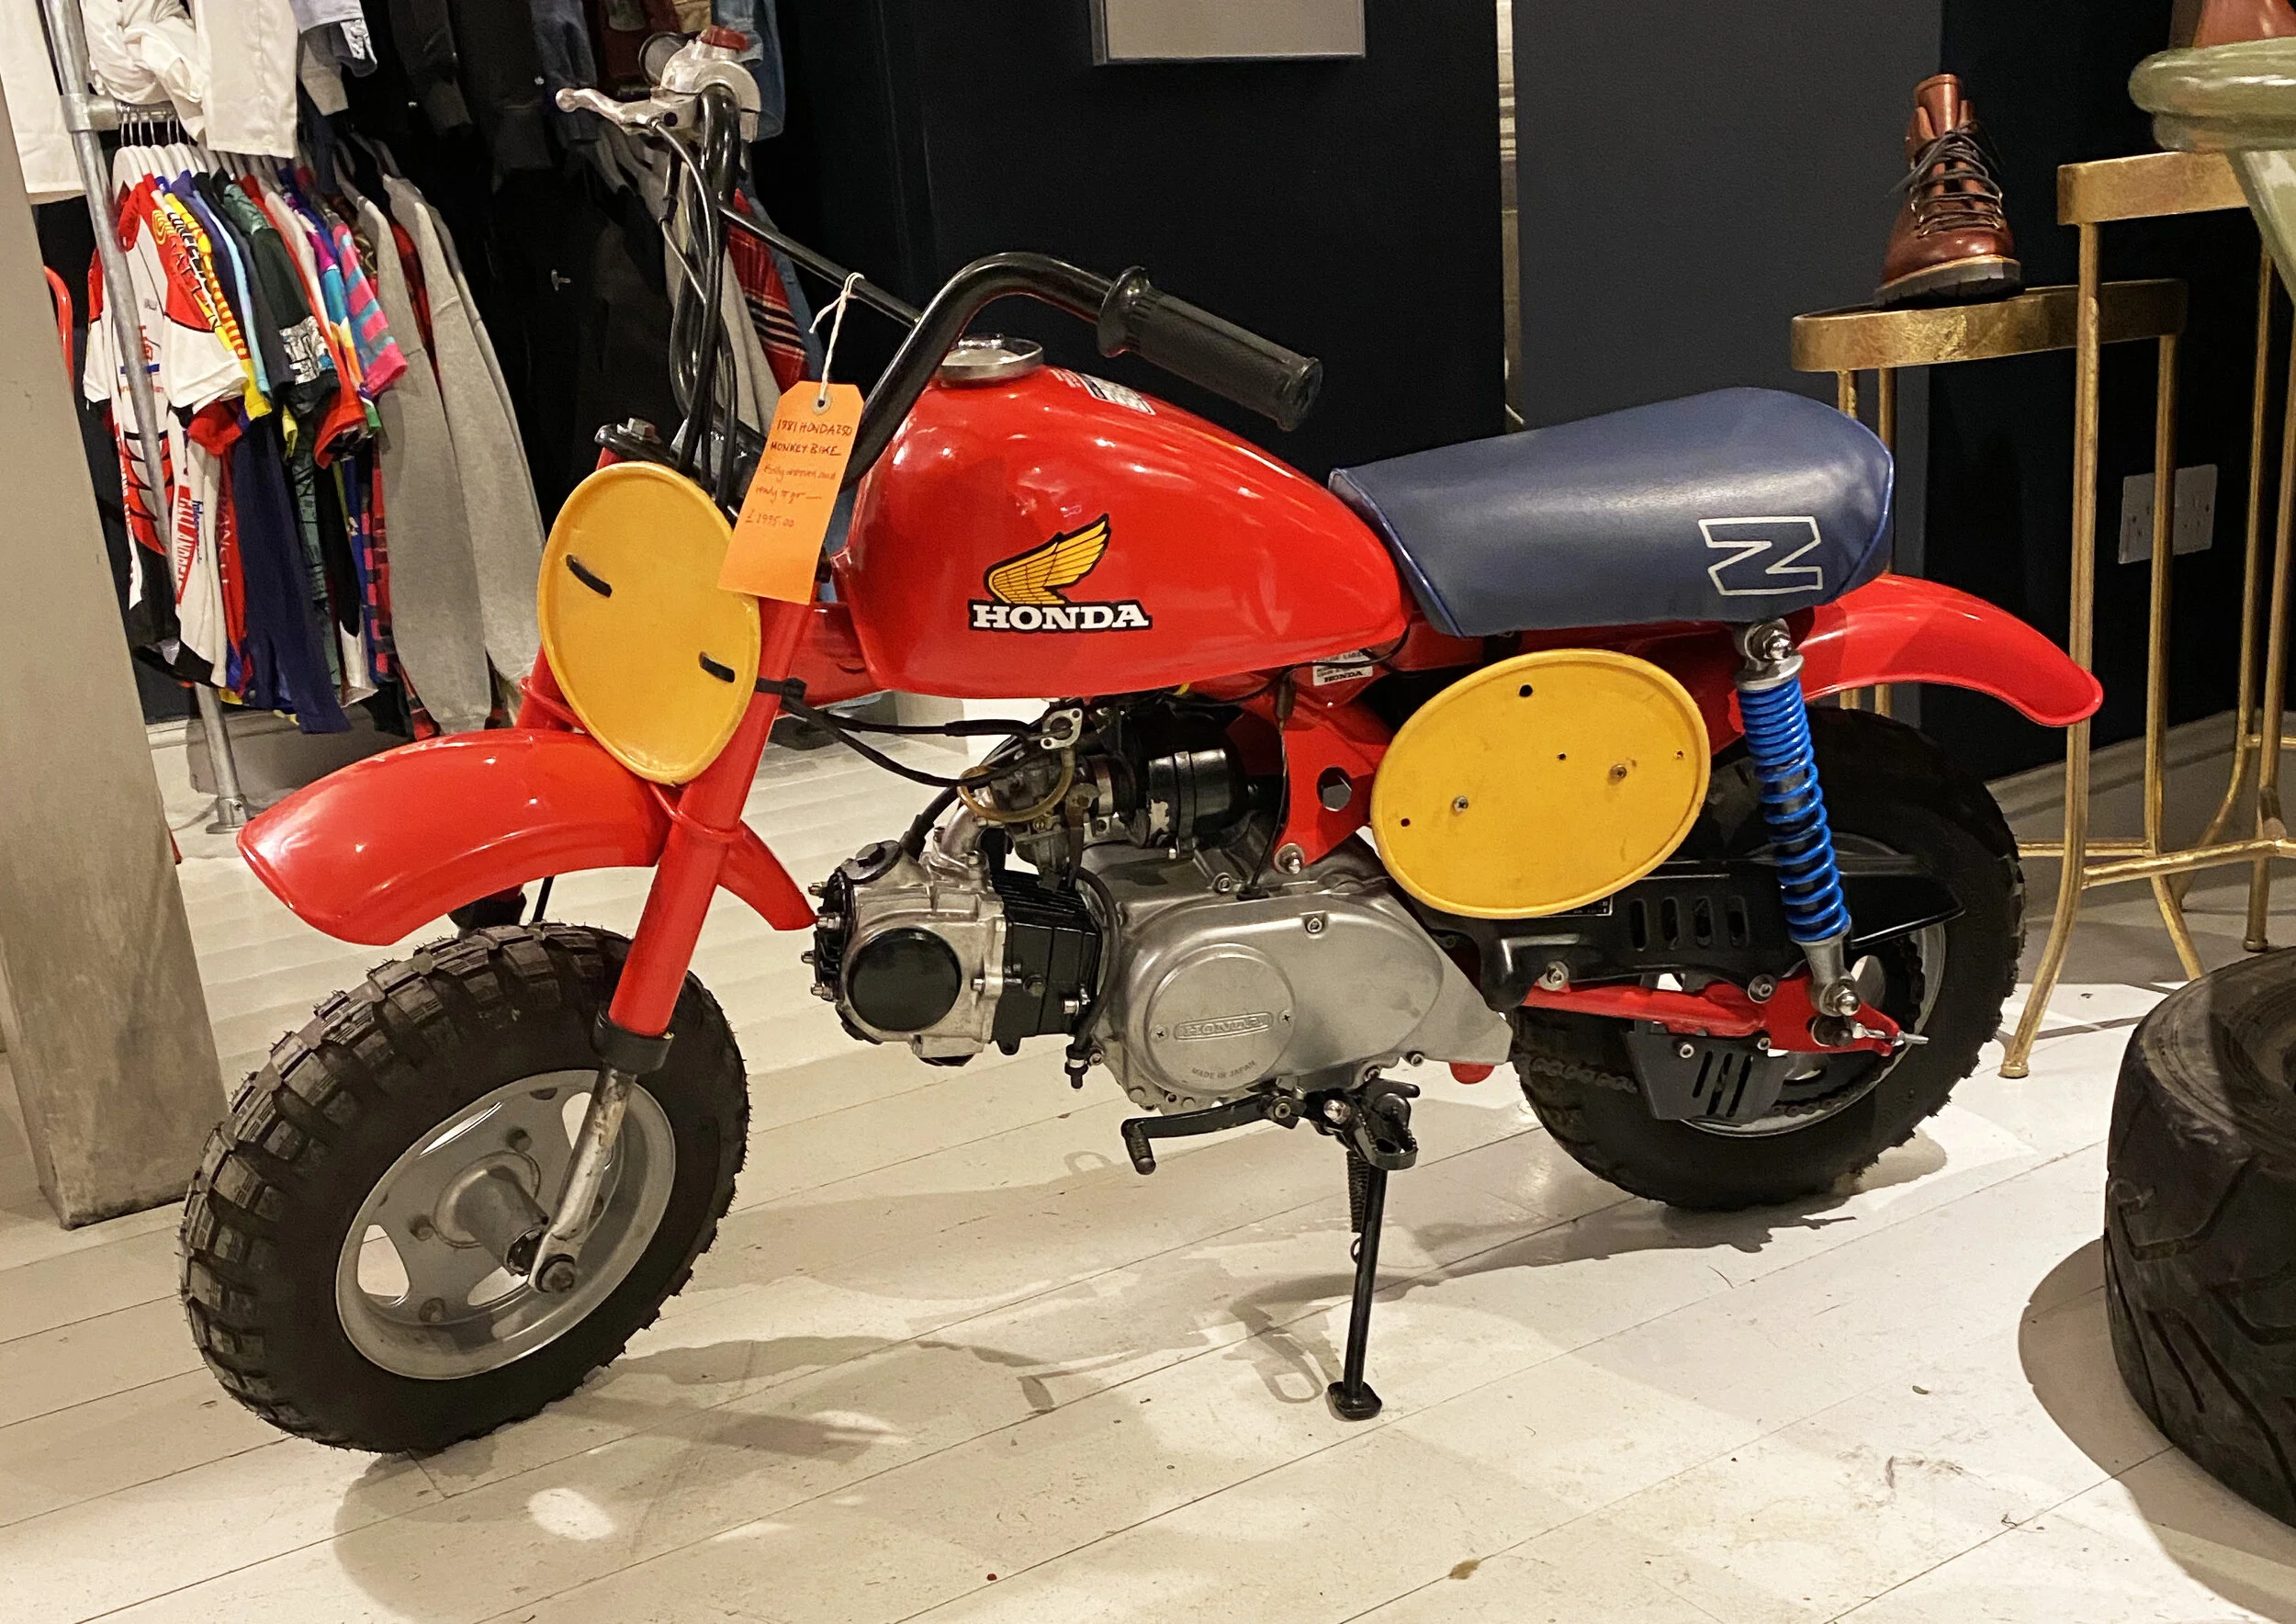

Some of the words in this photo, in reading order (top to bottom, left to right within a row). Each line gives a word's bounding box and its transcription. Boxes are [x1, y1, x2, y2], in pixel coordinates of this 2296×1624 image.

[776, 419, 797, 432] 1981
[770, 441, 808, 454] MONKEY
[809, 443, 842, 457] BIKE
[972, 603, 1150, 631] HONDA
[1324, 671, 1364, 682] HONDA
[1186, 1018, 1263, 1035] HONDA
[1191, 1066, 1216, 1080] MADE
[1217, 1071, 1227, 1080] IN
[1229, 1059, 1256, 1078] JAPAN
